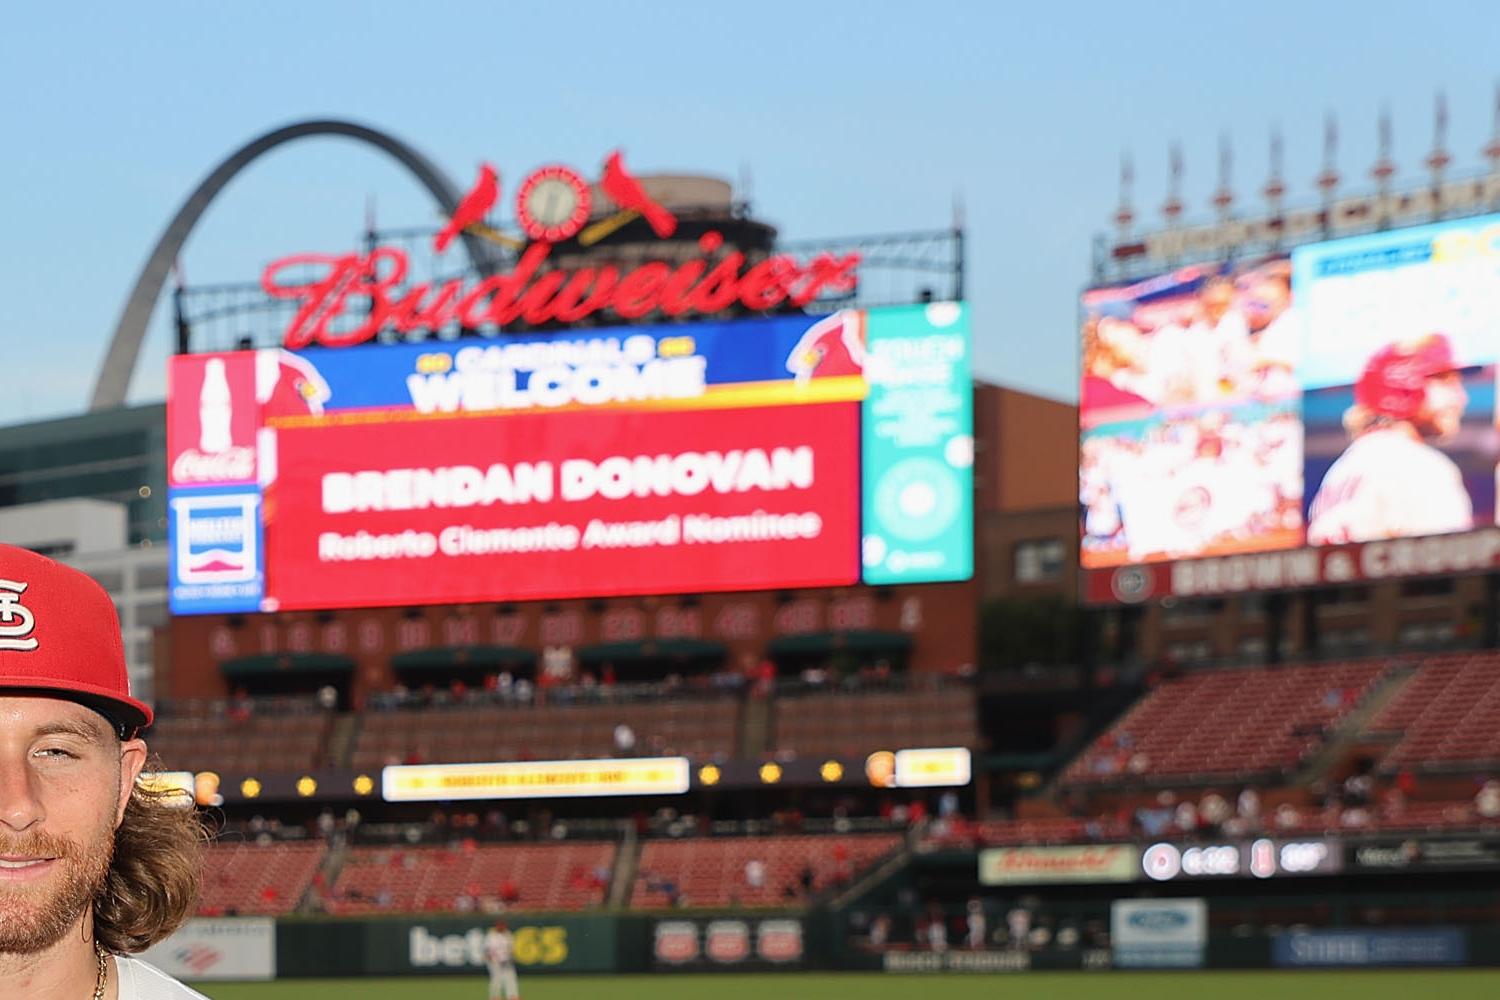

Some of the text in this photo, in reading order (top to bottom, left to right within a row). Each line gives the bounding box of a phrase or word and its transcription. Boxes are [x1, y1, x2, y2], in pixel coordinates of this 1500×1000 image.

[261, 230, 862, 350] Budweiser
[406, 355, 707, 413] WELCOME
[321, 445, 814, 514] BRENDAN DONOVAN
[318, 509, 822, 562] Roberto Clemente Award Nominee
[1172, 546, 1318, 596] BROWN
[409, 926, 567, 967] bet65
